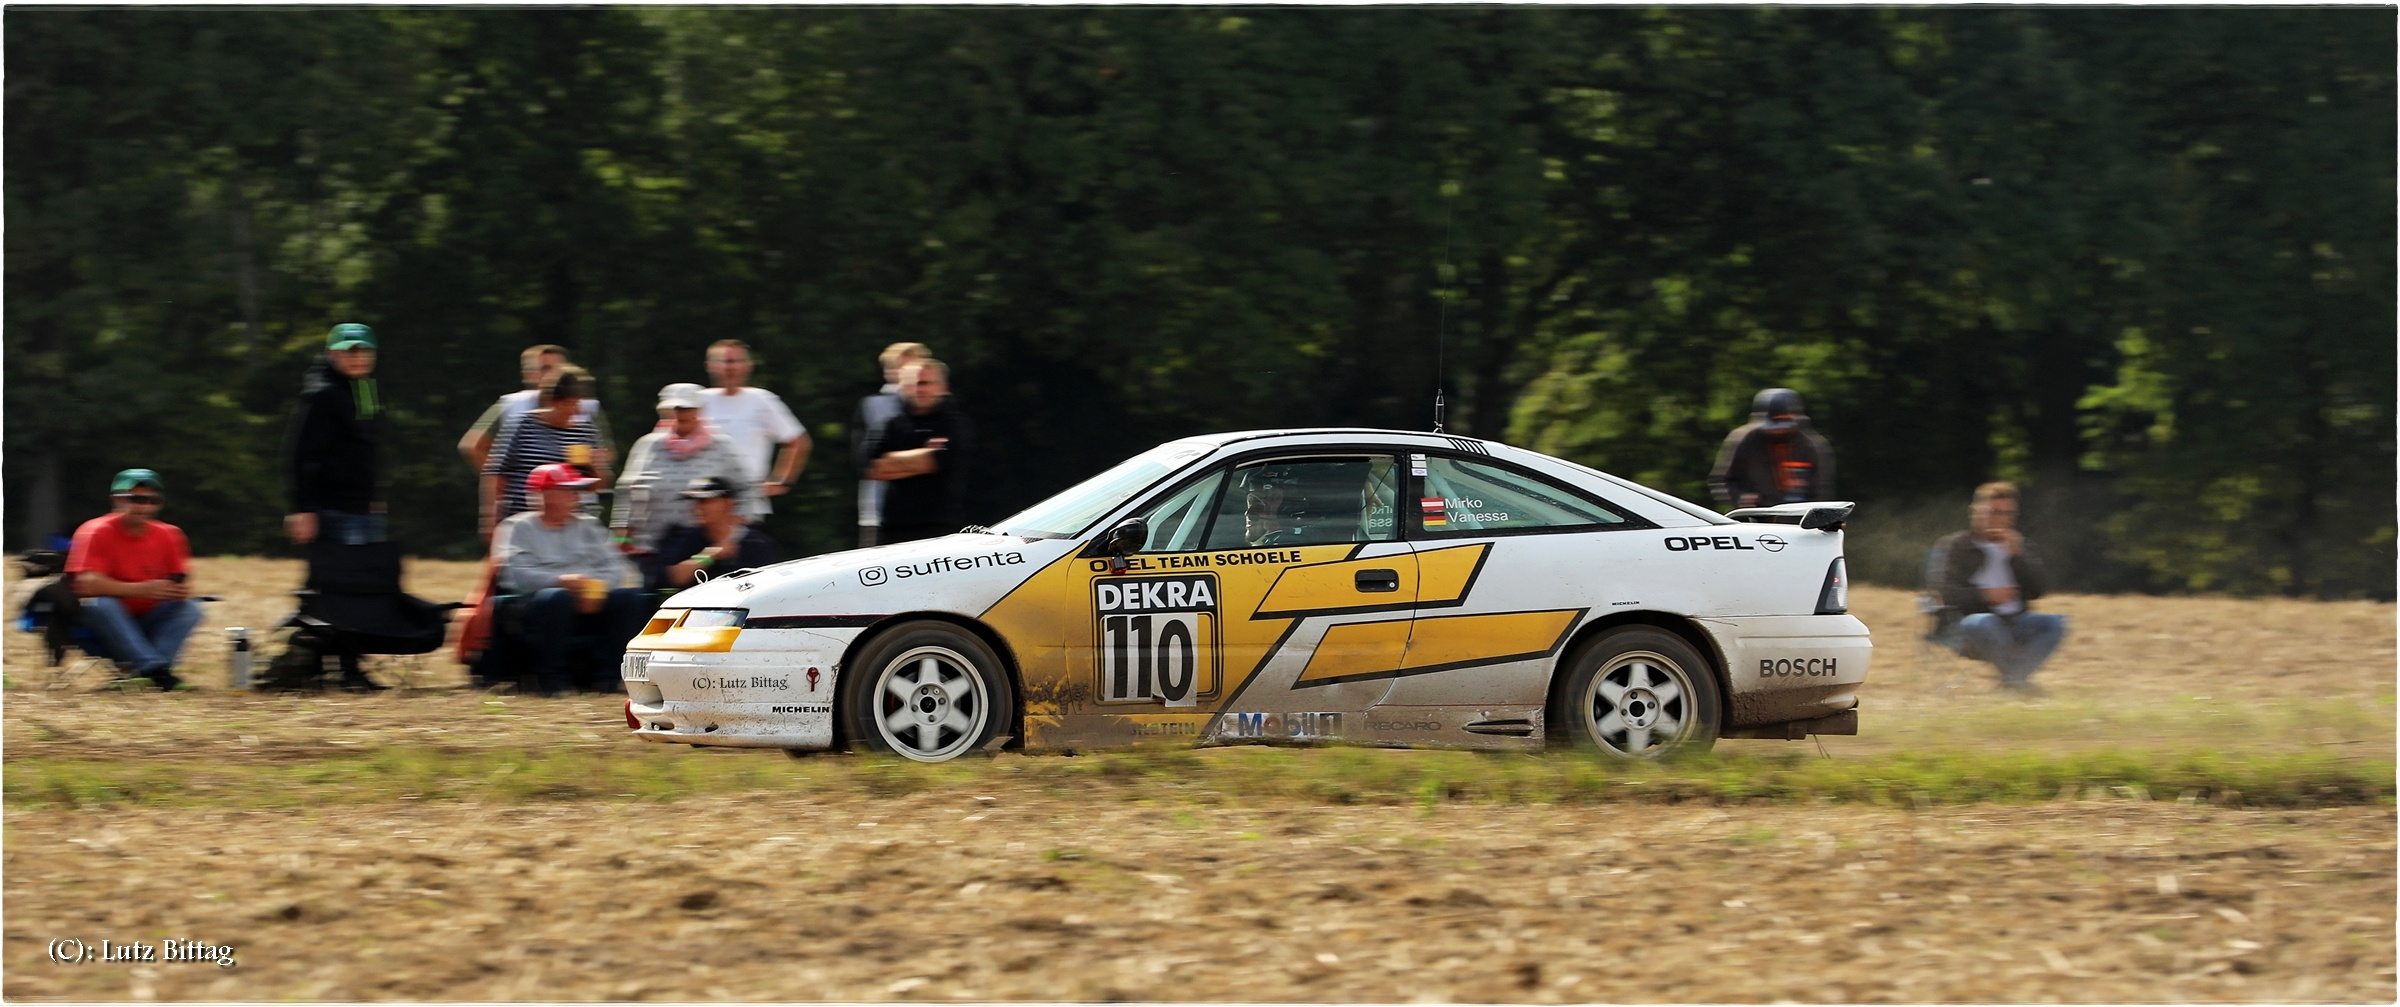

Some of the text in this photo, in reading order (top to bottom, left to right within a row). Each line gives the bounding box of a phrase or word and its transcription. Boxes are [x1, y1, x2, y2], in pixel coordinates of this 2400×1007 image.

[1445, 496, 1483, 509] Mirko
[1447, 511, 1509, 523] Vanessa
[1664, 536, 1754, 551] OPEL
[895, 552, 1026, 579] suffenta
[1089, 550, 1302, 572] OEL TEAM SCHOELE
[1097, 580, 1215, 611] DEKRA
[1106, 615, 1194, 701] 110
[1759, 658, 1837, 678] BOSCH
[1238, 713, 1315, 737] Mobil
[1364, 721, 1442, 731] RECARO
